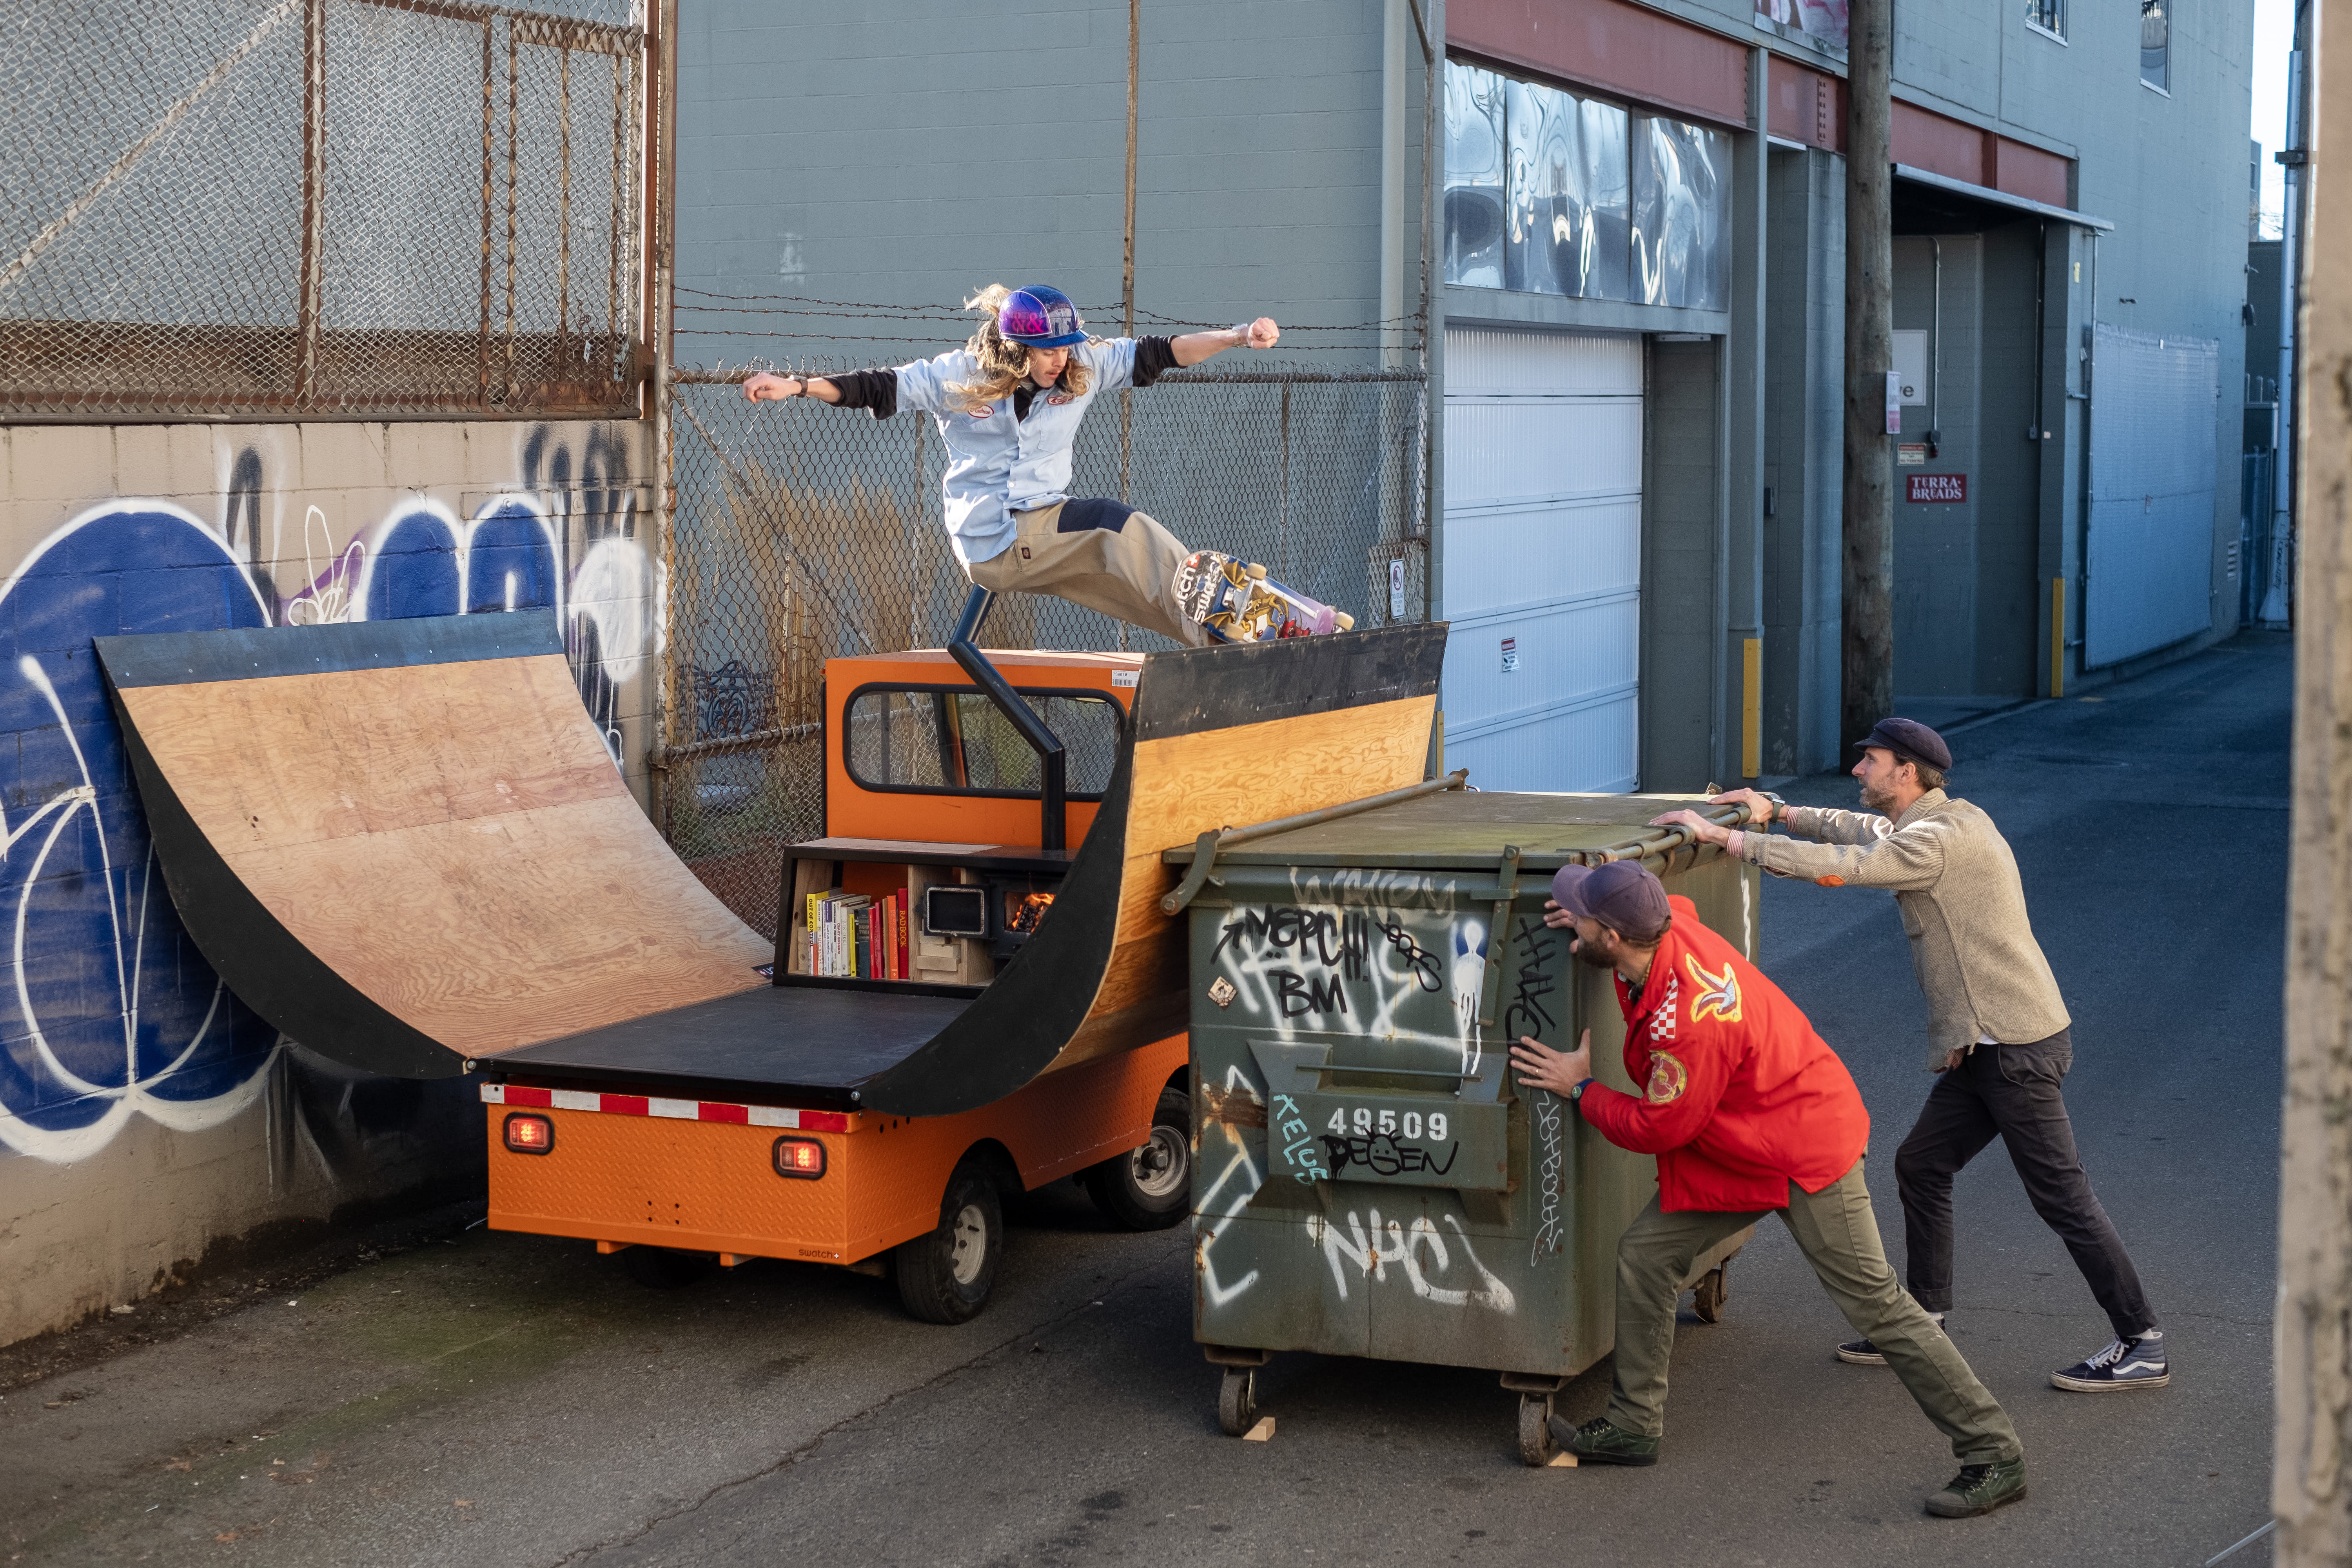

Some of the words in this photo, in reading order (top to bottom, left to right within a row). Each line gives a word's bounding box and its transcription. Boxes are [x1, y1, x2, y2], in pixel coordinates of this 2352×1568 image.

[1912, 488, 1962, 501] BREADS
[1267, 969, 1347, 1018] BM
[1328, 1107, 1447, 1141] 49509
[798, 1249, 833, 1259] swatch
